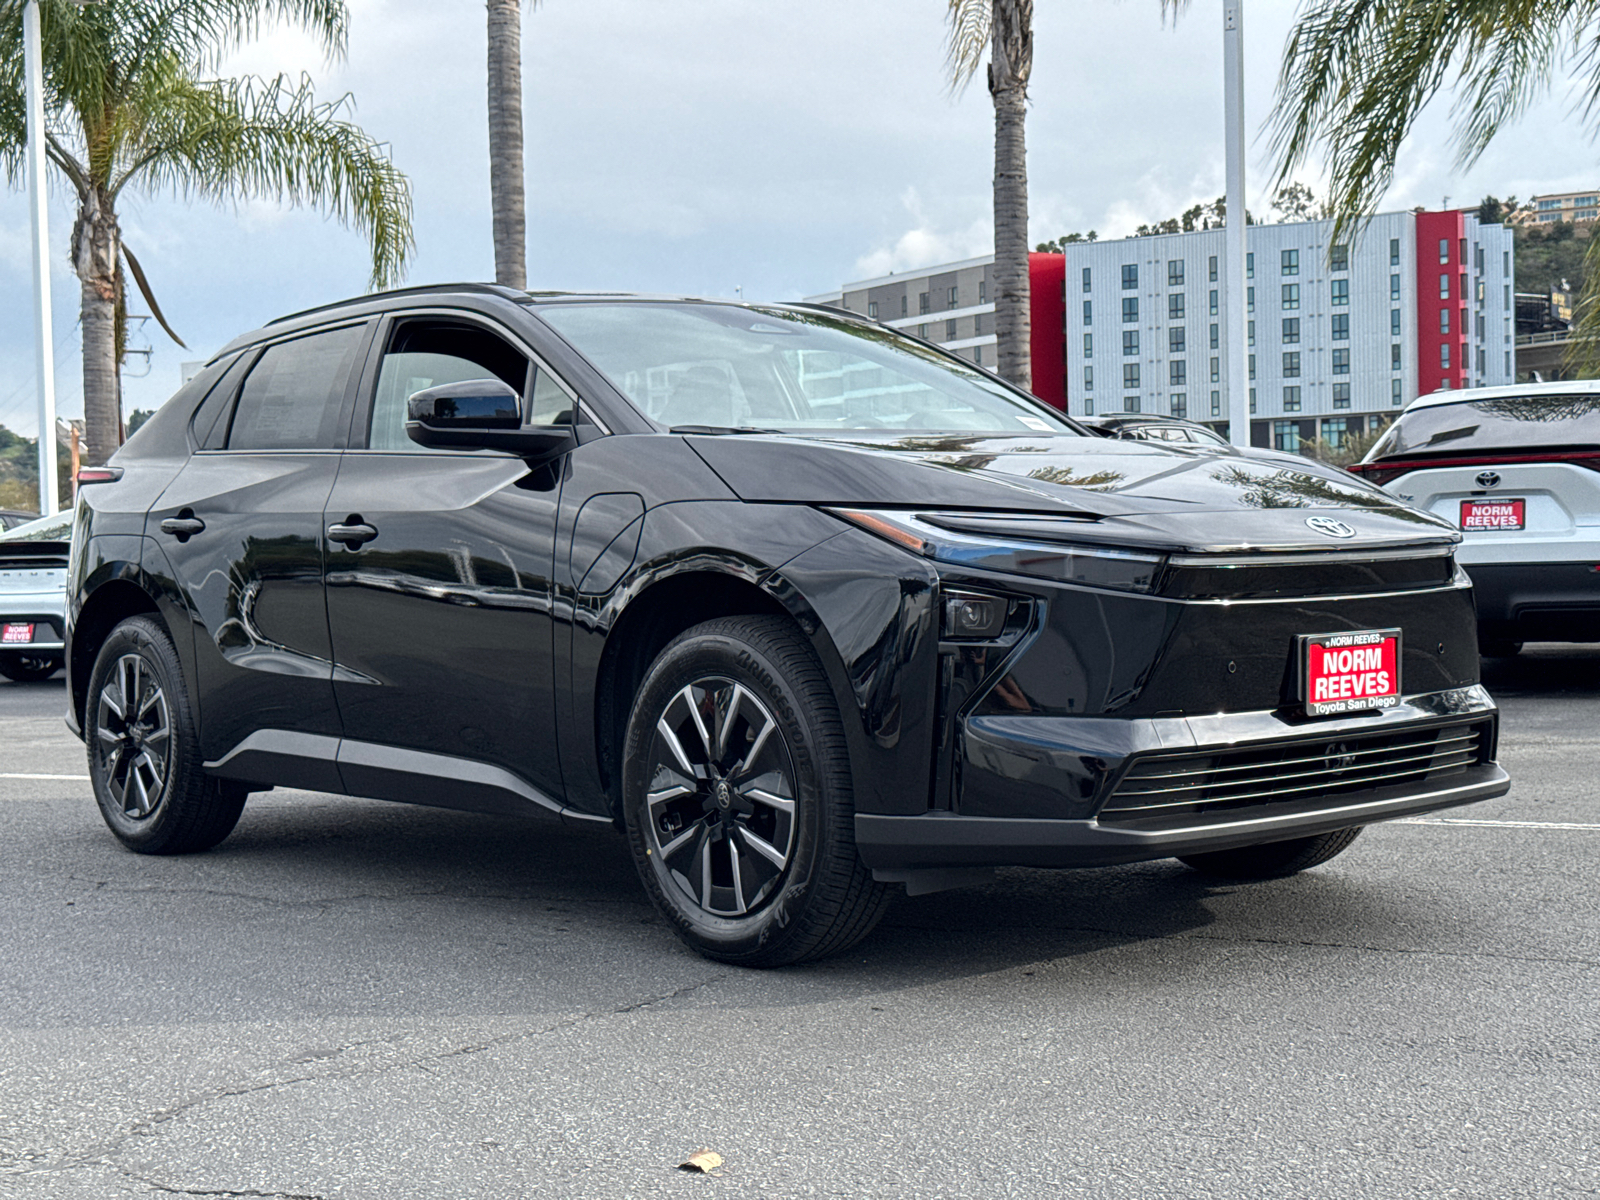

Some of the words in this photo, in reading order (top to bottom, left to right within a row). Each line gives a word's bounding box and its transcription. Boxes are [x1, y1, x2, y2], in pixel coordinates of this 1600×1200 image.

[1471, 506, 1513, 516] NORM
[1466, 516, 1518, 526] REEVES
[1330, 636, 1353, 647] NORM
[1354, 633, 1380, 645] REEVES
[1323, 647, 1382, 674] NORM
[1315, 670, 1390, 700] REEVES
[735, 650, 813, 773] BRIDGESTONE
[1314, 702, 1345, 715] Toyota
[1347, 699, 1366, 710] San
[1368, 696, 1396, 708] Diego
